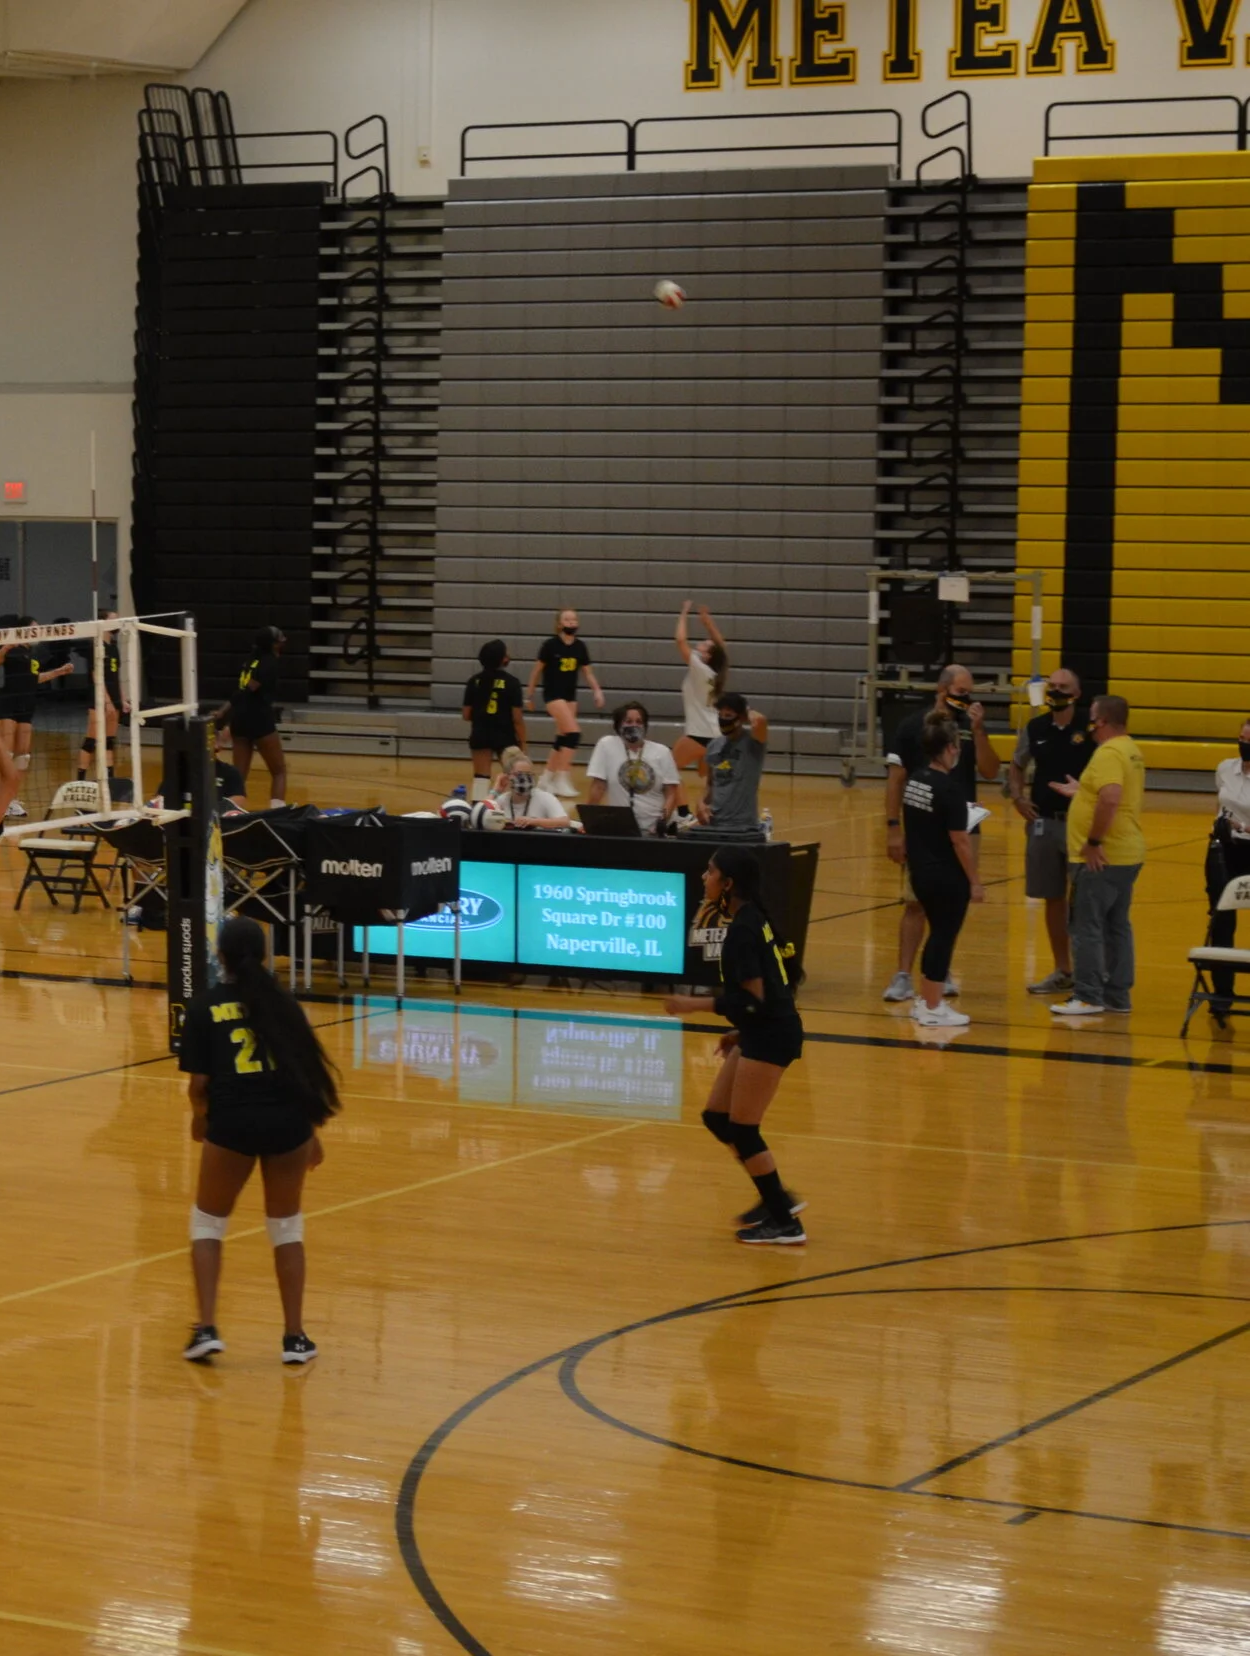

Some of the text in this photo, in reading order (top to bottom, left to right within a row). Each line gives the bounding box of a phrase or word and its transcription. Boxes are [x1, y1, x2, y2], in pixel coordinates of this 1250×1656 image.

[321, 858, 383, 877] molten
[411, 857, 452, 876] molten
[533, 884, 677, 908] 1960 Springbrook
[542, 909, 666, 930] Square Dr #100
[546, 934, 662, 958] Naperville, IL
[180, 917, 194, 998] sports imports
